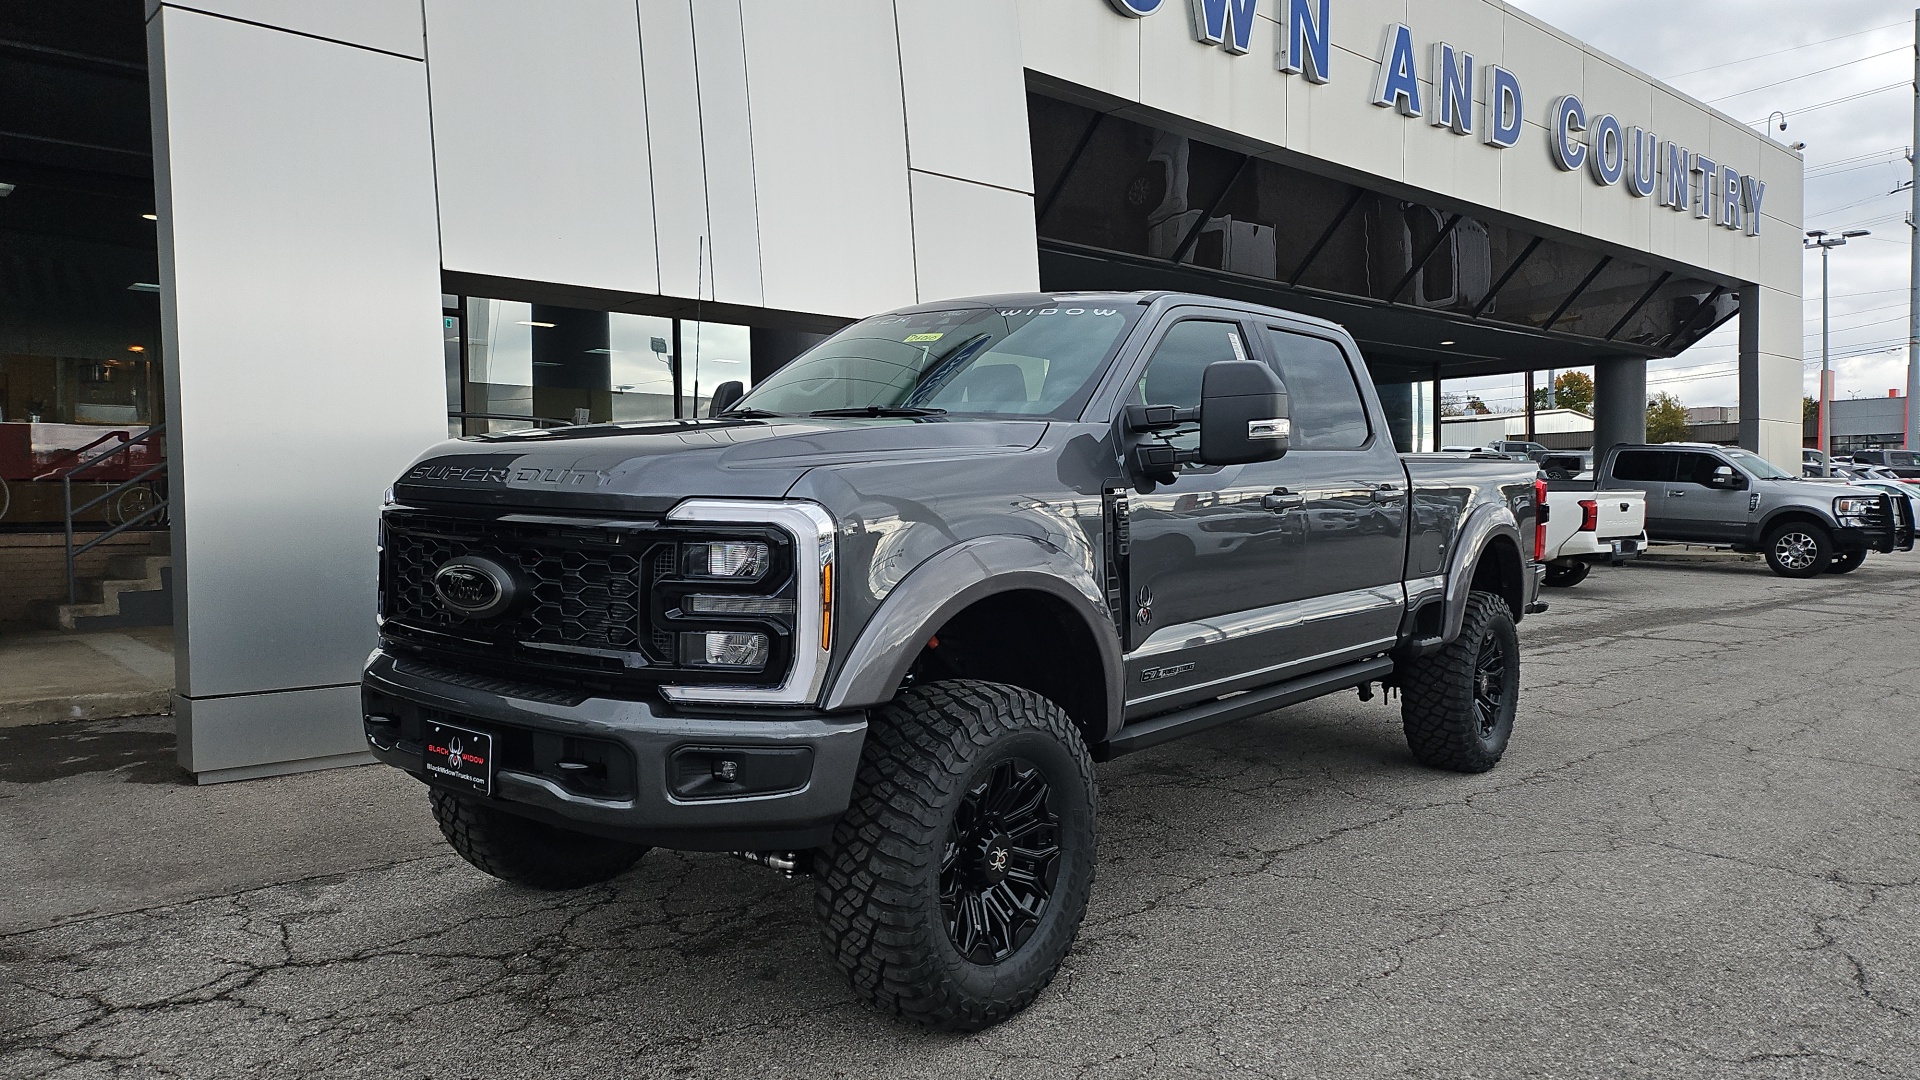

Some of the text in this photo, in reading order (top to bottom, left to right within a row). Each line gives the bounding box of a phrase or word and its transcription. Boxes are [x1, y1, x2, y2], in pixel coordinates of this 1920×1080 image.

[1373, 22, 1524, 149] AND
[1549, 94, 1767, 237] COUNTRY
[1001, 308, 1117, 317] WIDOW
[409, 465, 626, 486] SUPER DUTY
[448, 571, 484, 601] Ford
[428, 744, 484, 765] BLACK WIDOW
[426, 762, 485, 784] BlackWidowTrucks.com
